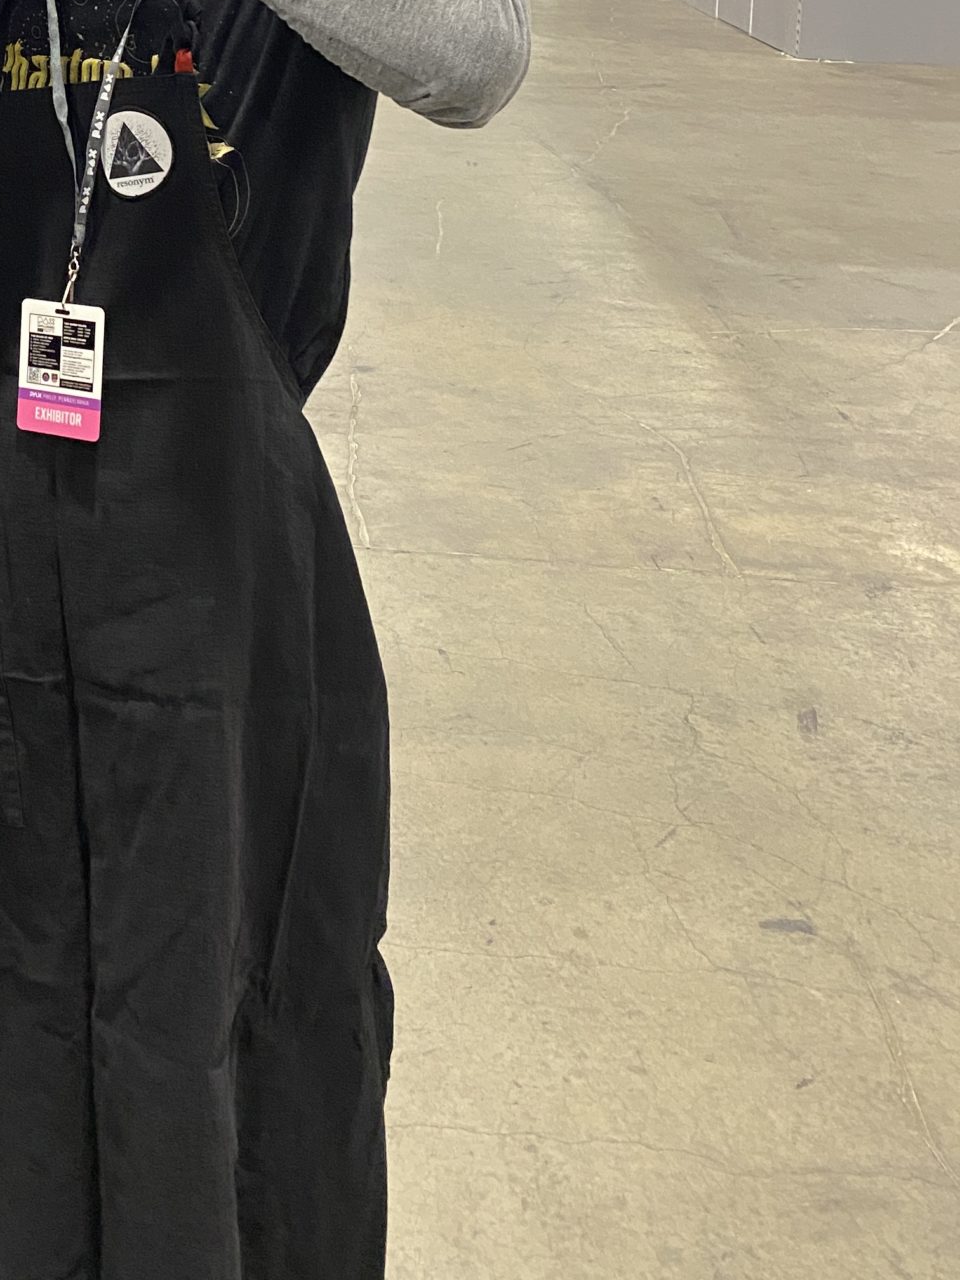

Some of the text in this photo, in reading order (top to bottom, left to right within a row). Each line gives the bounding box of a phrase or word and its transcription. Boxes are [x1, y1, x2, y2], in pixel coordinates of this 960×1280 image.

[91, 111, 105, 139] PAX
[116, 175, 155, 190] resonym
[35, 406, 83, 427] EXHIBITOR
